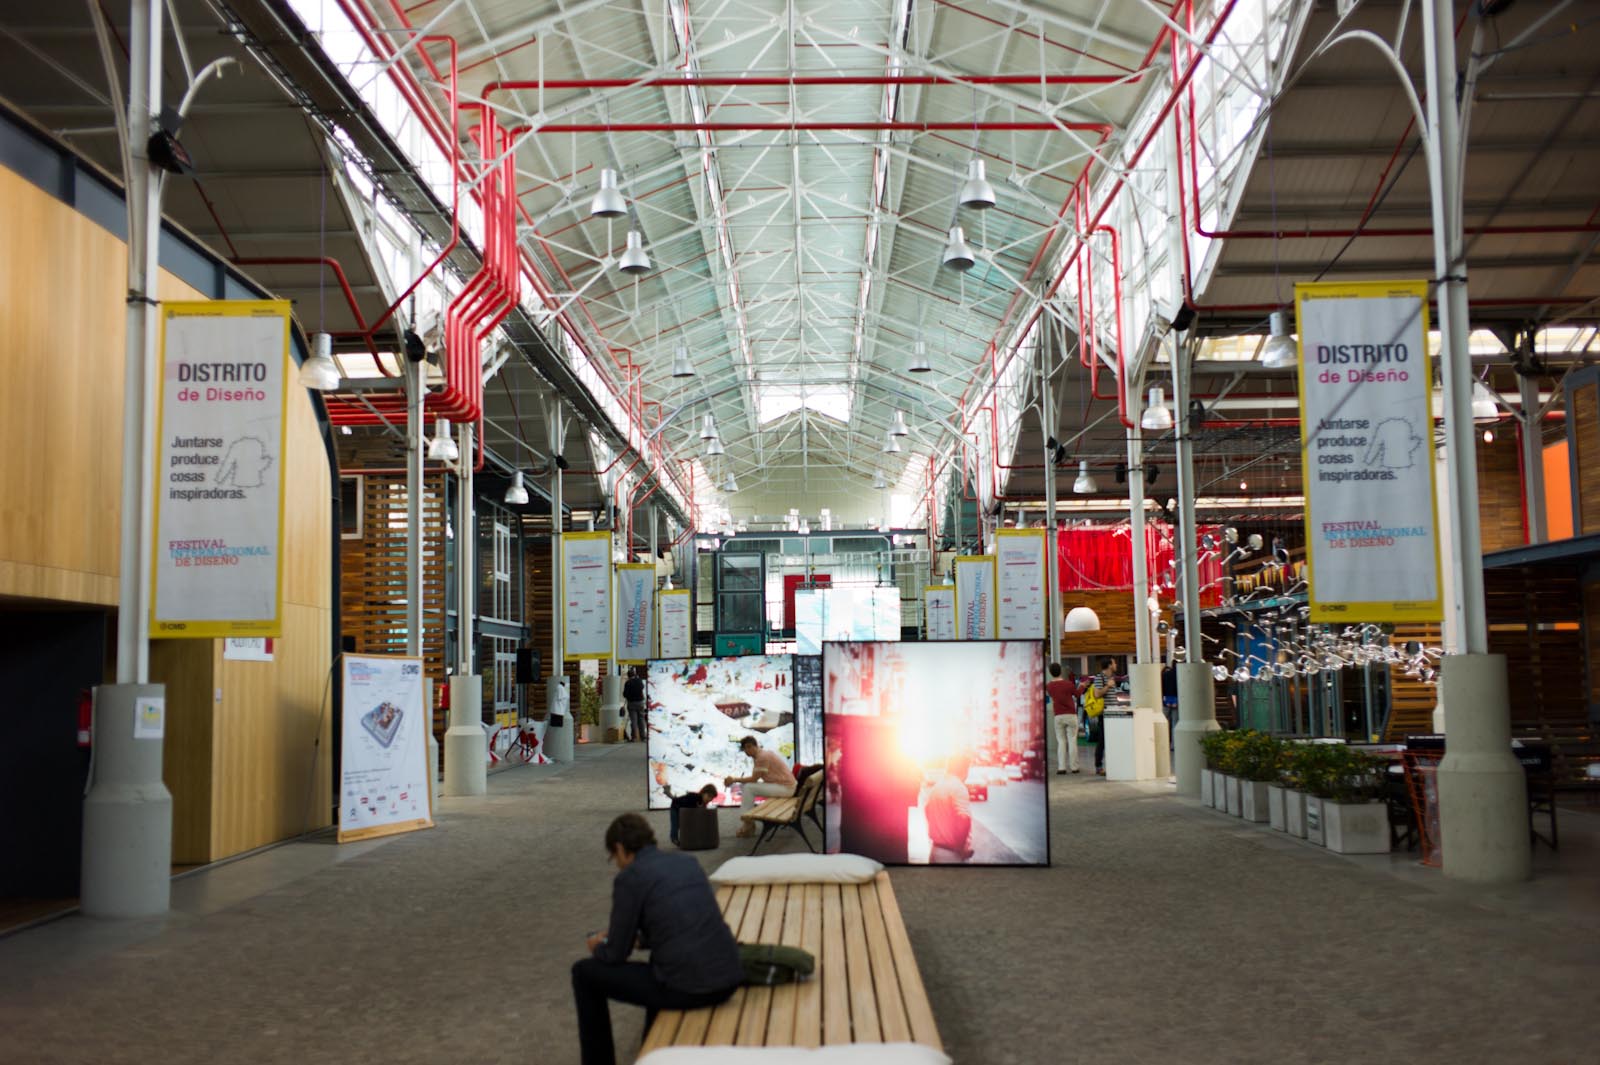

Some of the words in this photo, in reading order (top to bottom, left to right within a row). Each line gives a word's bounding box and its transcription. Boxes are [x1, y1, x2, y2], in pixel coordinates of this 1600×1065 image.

[1318, 344, 1408, 364] DISTRITO
[178, 363, 266, 382] DISTRITO
[1318, 369, 1341, 383] de
[1348, 368, 1409, 383] Diseño
[177, 387, 200, 401] de
[206, 387, 266, 401] Diseño
[1318, 418, 1370, 430] Juntarse
[171, 436, 223, 448] Juntarse
[1317, 435, 1367, 448] produce
[171, 454, 219, 467] produce
[1318, 454, 1354, 464] cosas
[170, 472, 205, 482] cosas
[1319, 469, 1398, 483] inspiradoras.
[170, 488, 247, 501] inspiradoras.
[1322, 520, 1381, 532] FESTIVAL
[169, 538, 226, 550] FESTIVAL
[1330, 538, 1345, 548] DE
[175, 557, 191, 567] DE
